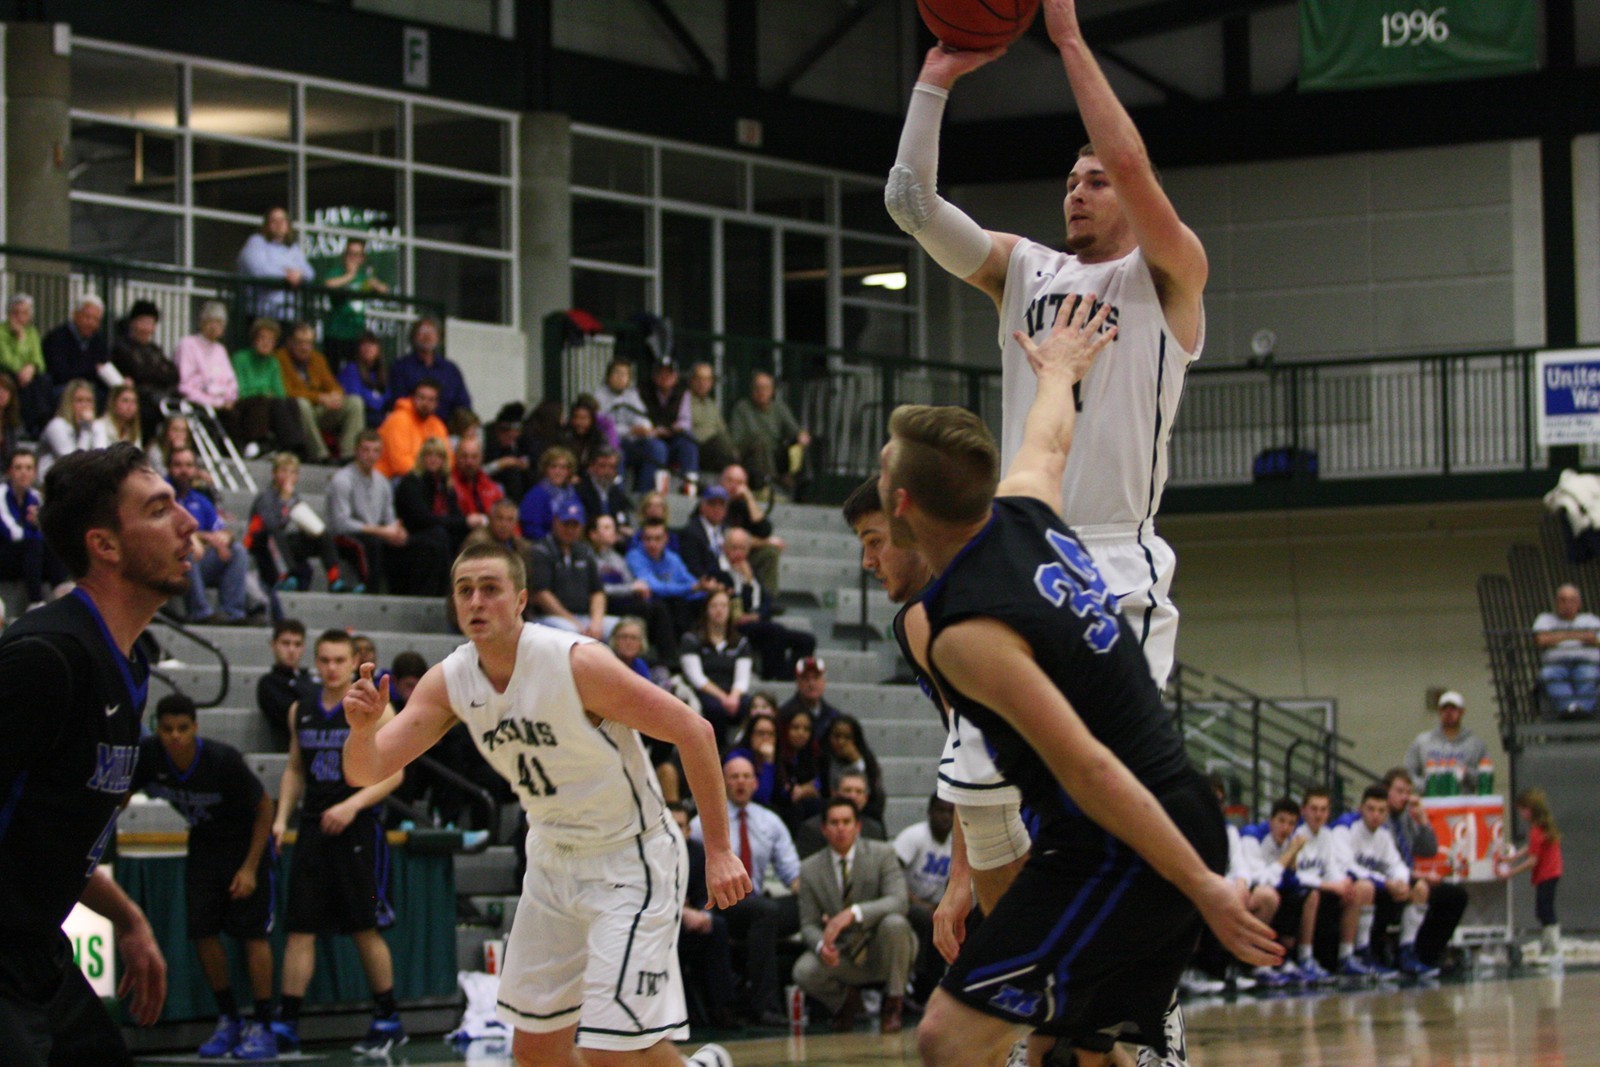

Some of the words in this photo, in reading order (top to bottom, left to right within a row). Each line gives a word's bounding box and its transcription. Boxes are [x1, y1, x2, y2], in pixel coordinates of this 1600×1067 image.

[1382, 7, 1449, 47] 1996
[409, 36, 422, 74] F
[1546, 366, 1600, 390] Unite
[1571, 386, 1600, 410] Wa
[517, 753, 557, 796] 41
